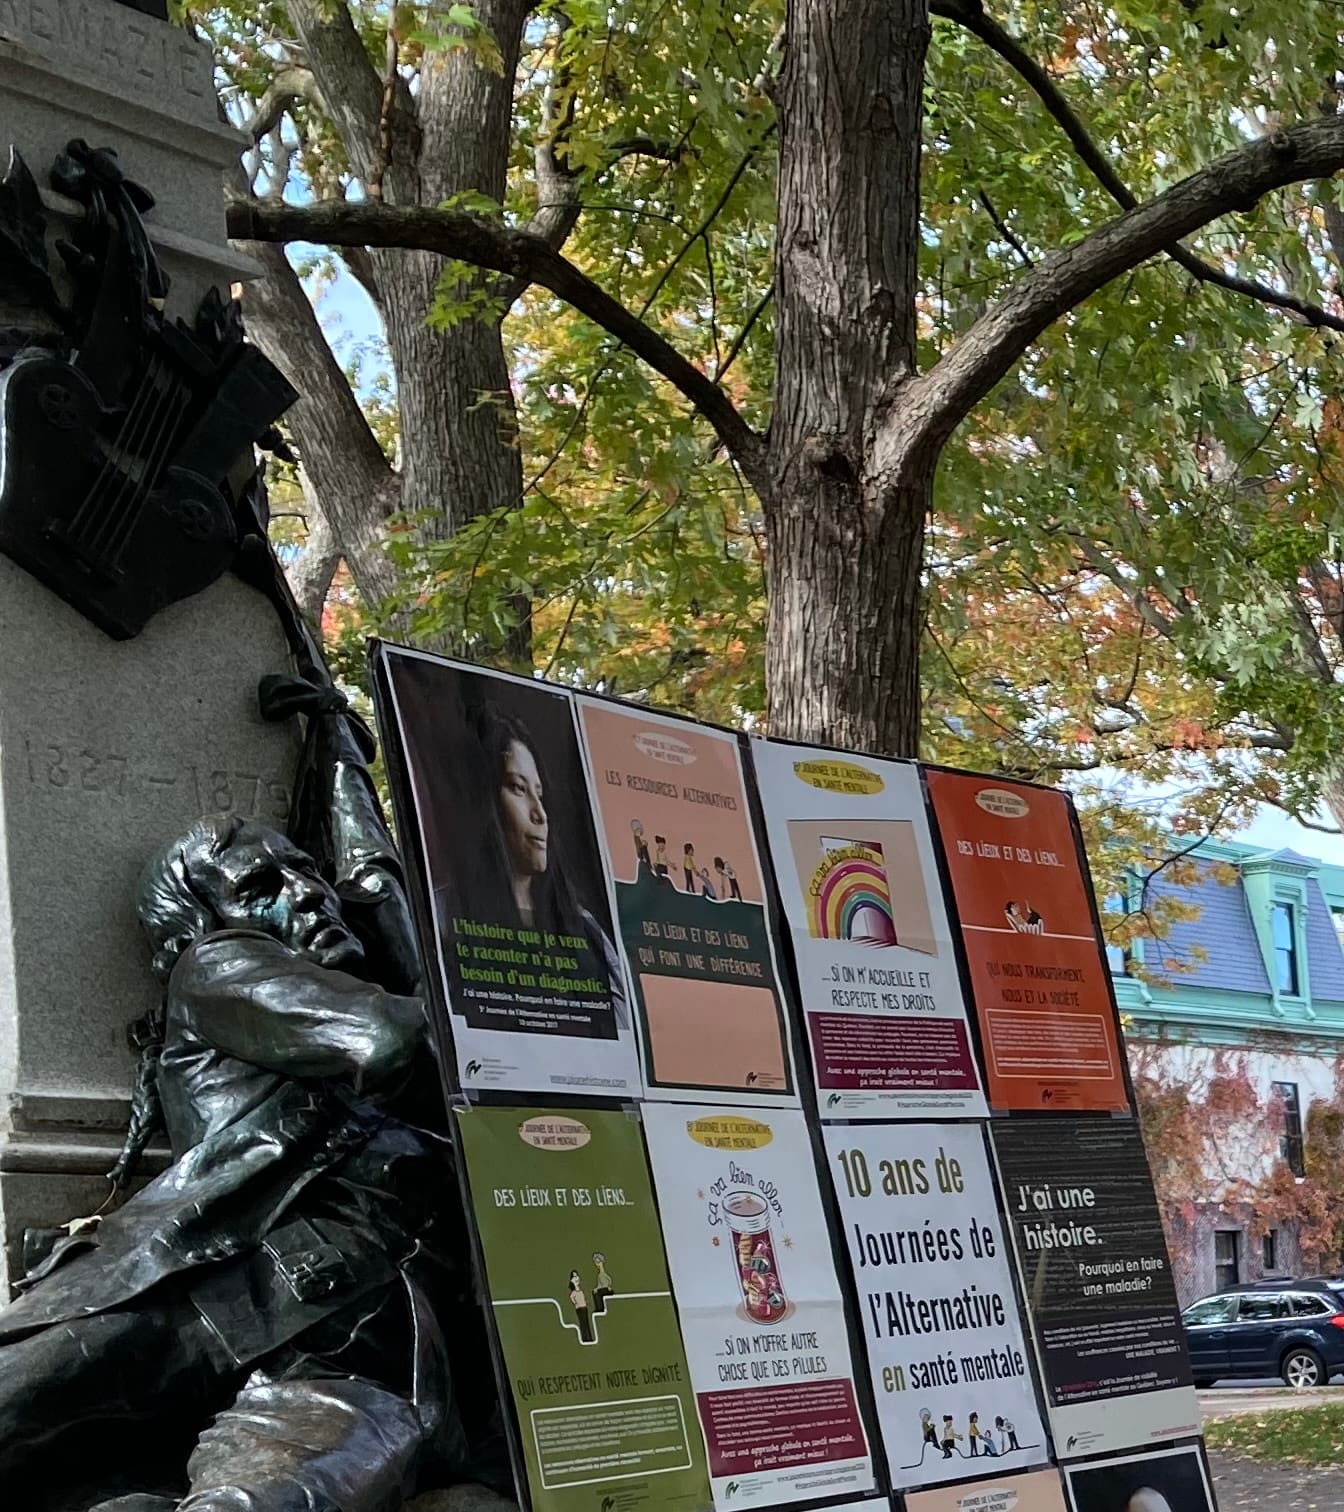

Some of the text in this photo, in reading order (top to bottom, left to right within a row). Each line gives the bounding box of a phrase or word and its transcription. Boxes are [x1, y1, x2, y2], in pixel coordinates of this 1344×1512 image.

[605, 769, 622, 786] LES
[626, 774, 678, 799] RESSOURCES
[957, 840, 973, 856] DES
[1003, 846, 1014, 861] ET
[1016, 849, 1032, 863] DES
[452, 917, 588, 950] L'histoire que je veux
[642, 921, 660, 937] DES
[663, 922, 688, 942] LIEUX
[690, 927, 701, 943] ET
[705, 929, 720, 946] DES
[456, 942, 578, 971] te raconter n'a pas
[638, 945, 763, 978] QUI FONT UNE DIFFÉRENCE
[460, 965, 607, 994] besoin d'un diagnostic.
[842, 966, 855, 984] ON
[918, 972, 931, 989] ET
[831, 989, 936, 1012] RESPECTE MES DROITS
[709, 1177, 728, 1197] va
[729, 1160, 755, 1187] bien
[838, 1146, 964, 1198] 10 ans de
[493, 1188, 516, 1208] DES
[520, 1184, 551, 1207] LIEUX
[555, 1188, 567, 1206] ET
[572, 1188, 592, 1206] DES
[1018, 1184, 1096, 1212] J'ai une
[854, 1217, 996, 1268] Journées de
[1023, 1221, 1103, 1250] histoire.
[1079, 1257, 1164, 1278] Pourquoi en faire
[1083, 1276, 1152, 1297] une maladie?
[867, 1284, 1006, 1338] l'Alternative
[736, 1336, 751, 1355] ON
[752, 1333, 788, 1354] M'OFFRE
[791, 1331, 819, 1350] AUTRE
[517, 1362, 683, 1401] QUI RESPECTENT NOTRE DIGNITÉ
[718, 1356, 828, 1382] CHOSE QUE DES PILULES
[882, 1344, 1025, 1393] en santé mentale
